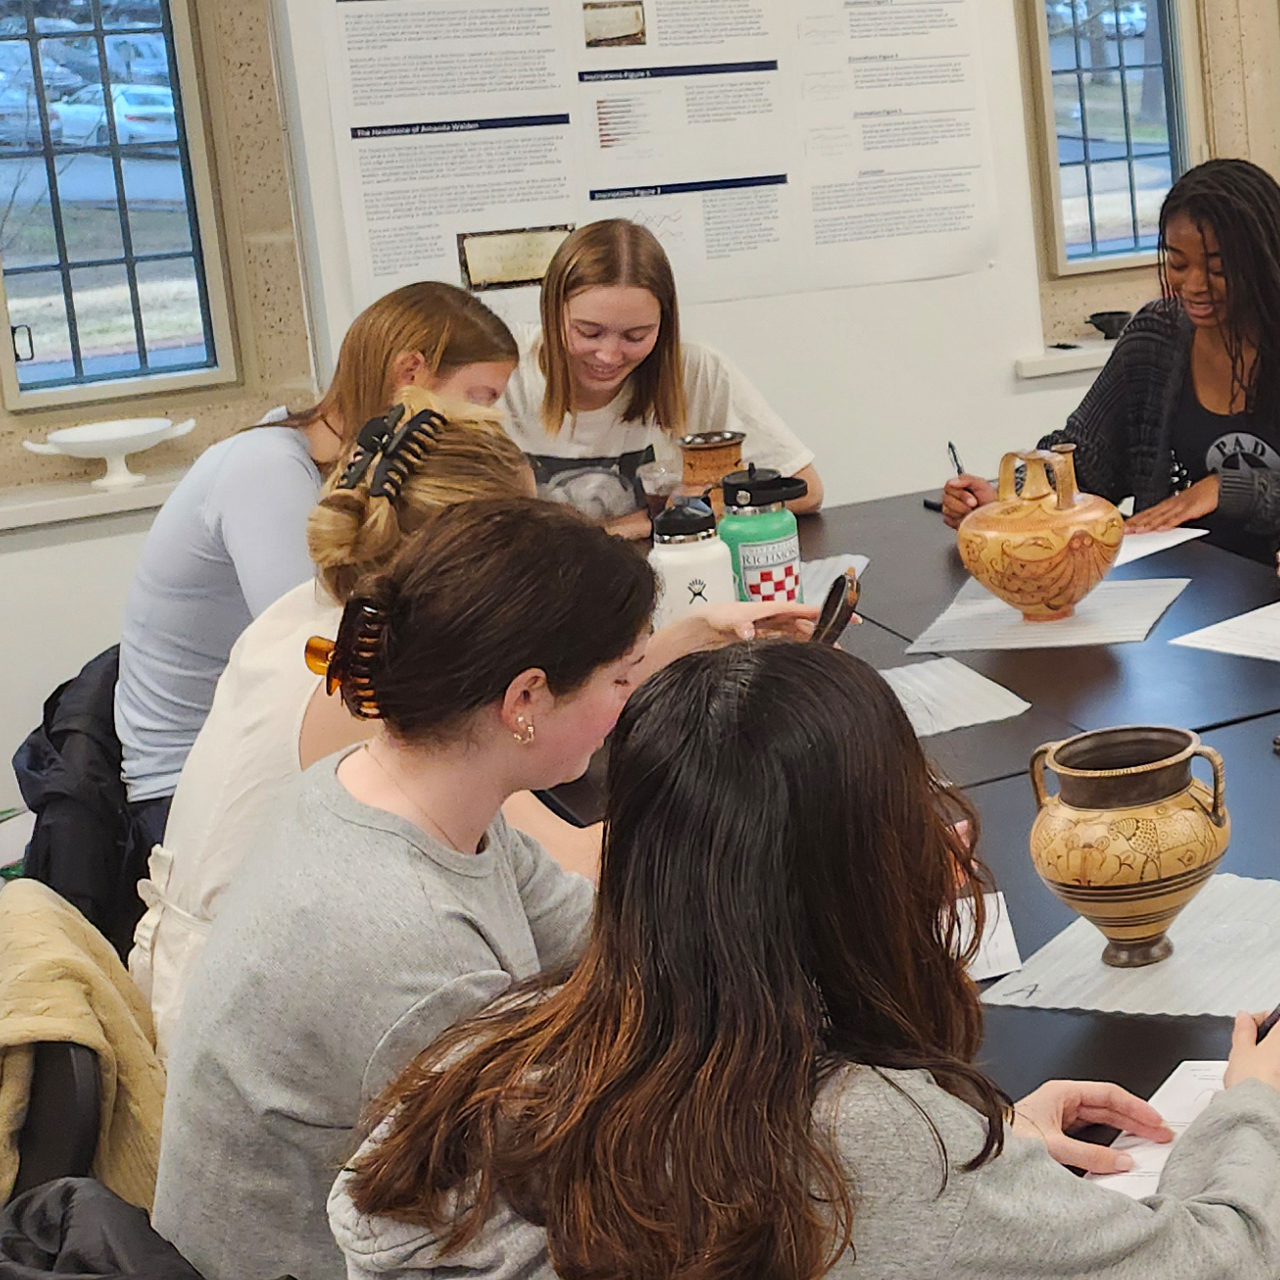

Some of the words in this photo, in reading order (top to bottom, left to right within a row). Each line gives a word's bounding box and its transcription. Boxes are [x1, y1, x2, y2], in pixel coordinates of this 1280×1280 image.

[357, 129, 371, 138] The
[412, 125, 420, 135] of
[421, 123, 450, 134] Amanda
[742, 546, 797, 565] RICHMON
